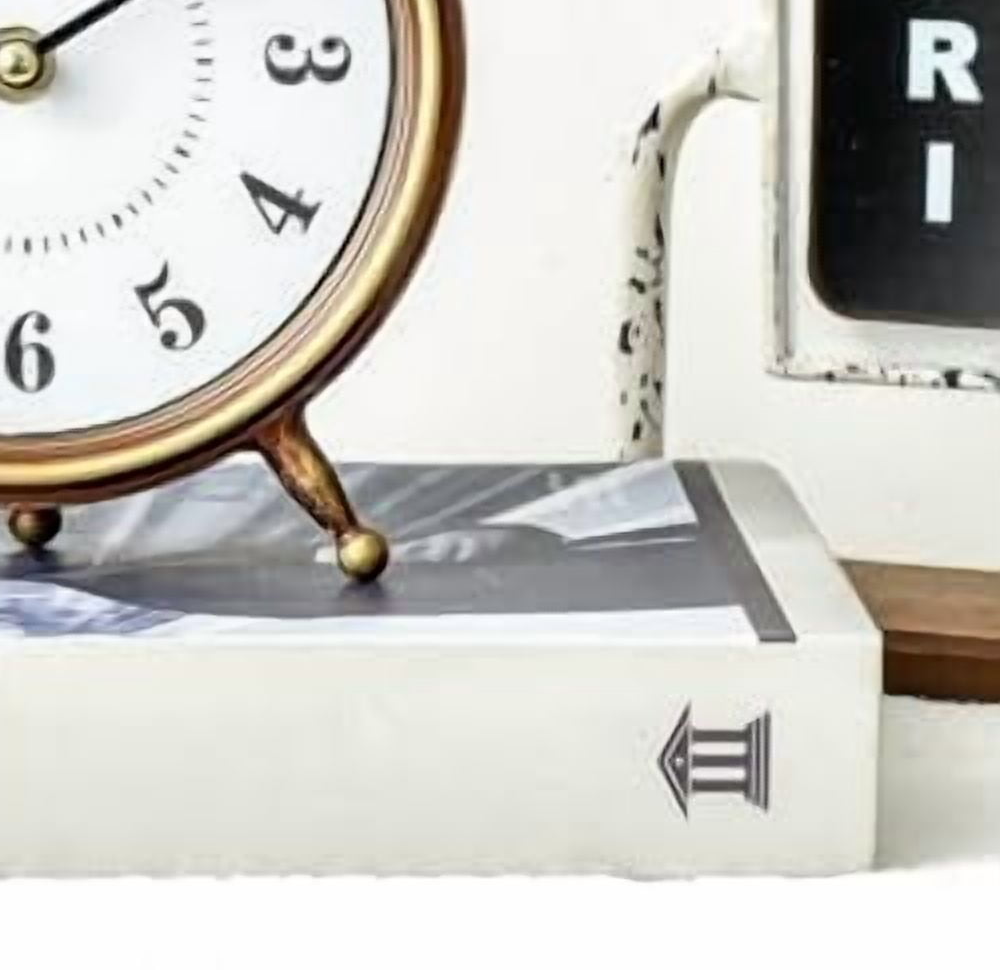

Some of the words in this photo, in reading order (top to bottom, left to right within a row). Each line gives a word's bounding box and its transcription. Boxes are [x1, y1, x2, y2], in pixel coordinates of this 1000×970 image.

[263, 33, 353, 87] 3
[239, 171, 323, 236] 4
[133, 261, 207, 351] 5
[3, 311, 56, 393] 6
